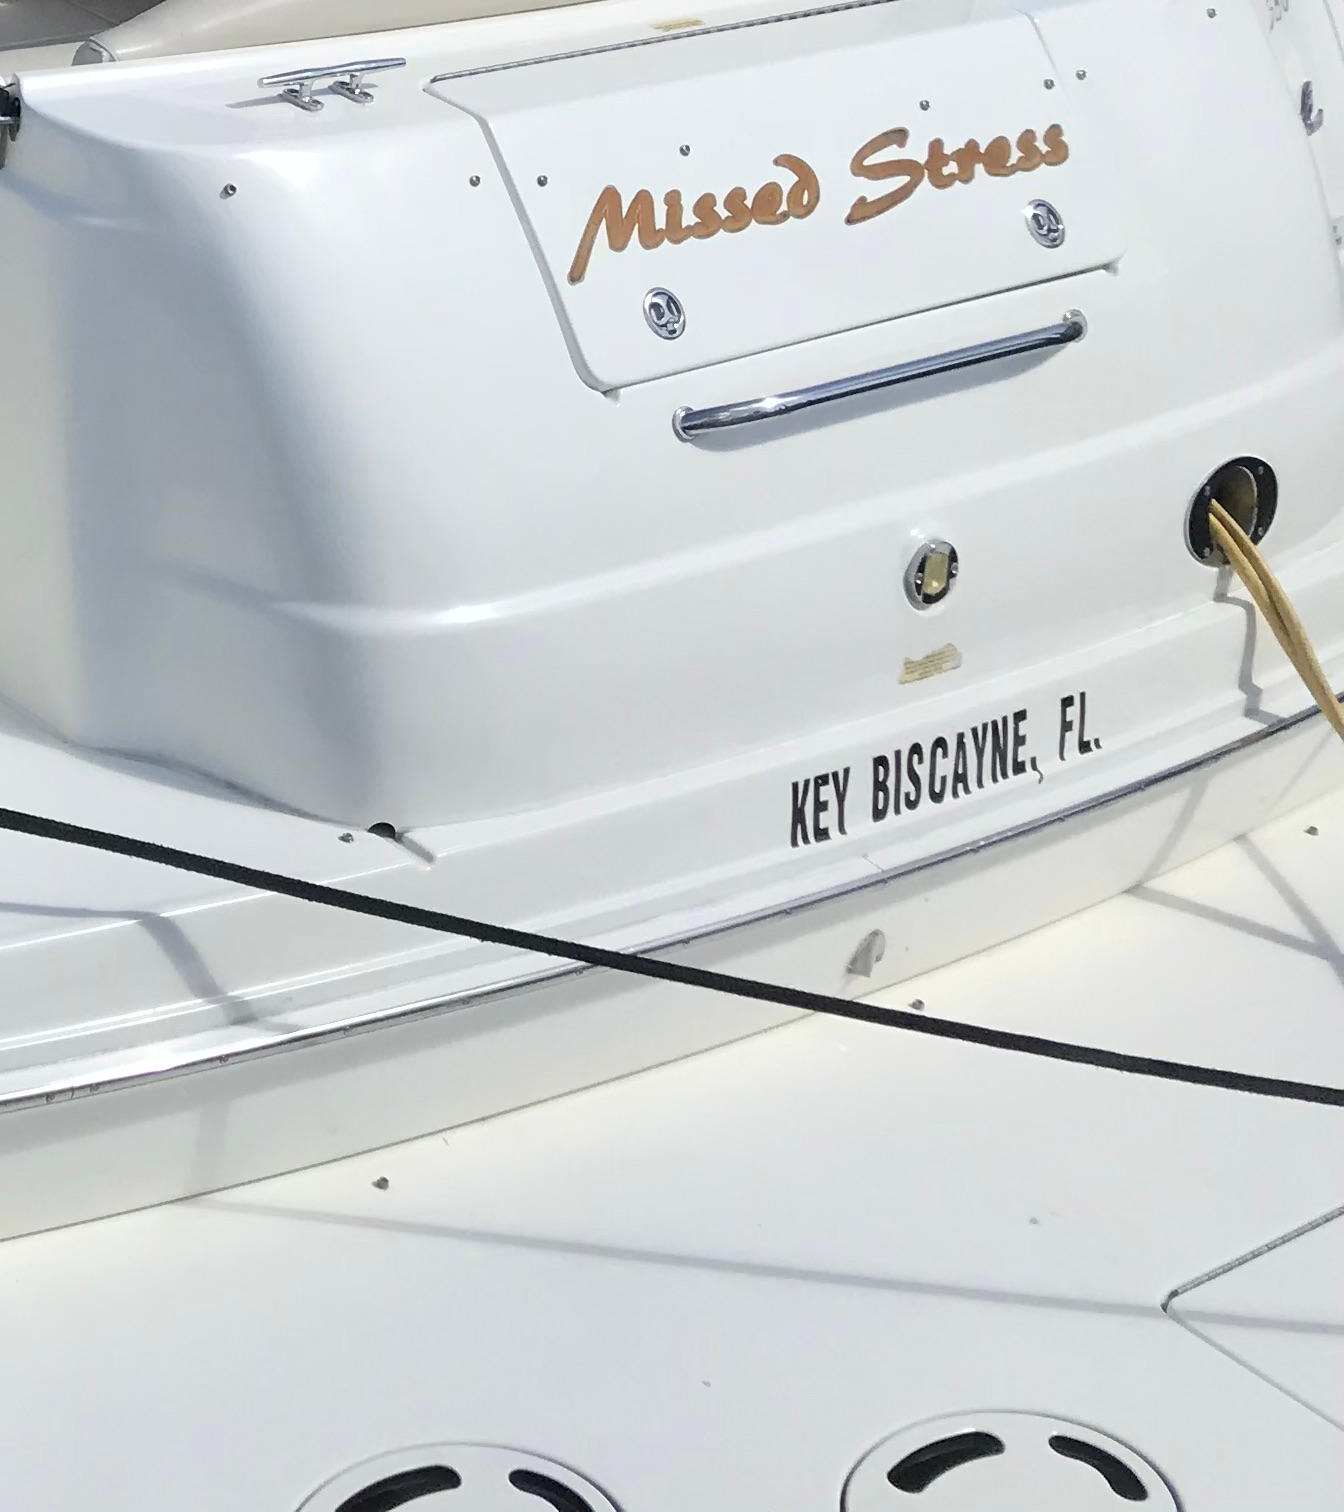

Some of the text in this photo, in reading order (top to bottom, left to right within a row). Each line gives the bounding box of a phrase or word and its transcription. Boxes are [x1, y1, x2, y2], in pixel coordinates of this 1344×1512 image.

[567, 123, 1071, 286] Missed Stress
[790, 690, 1103, 848] KEY BISCAYNE, FL.
